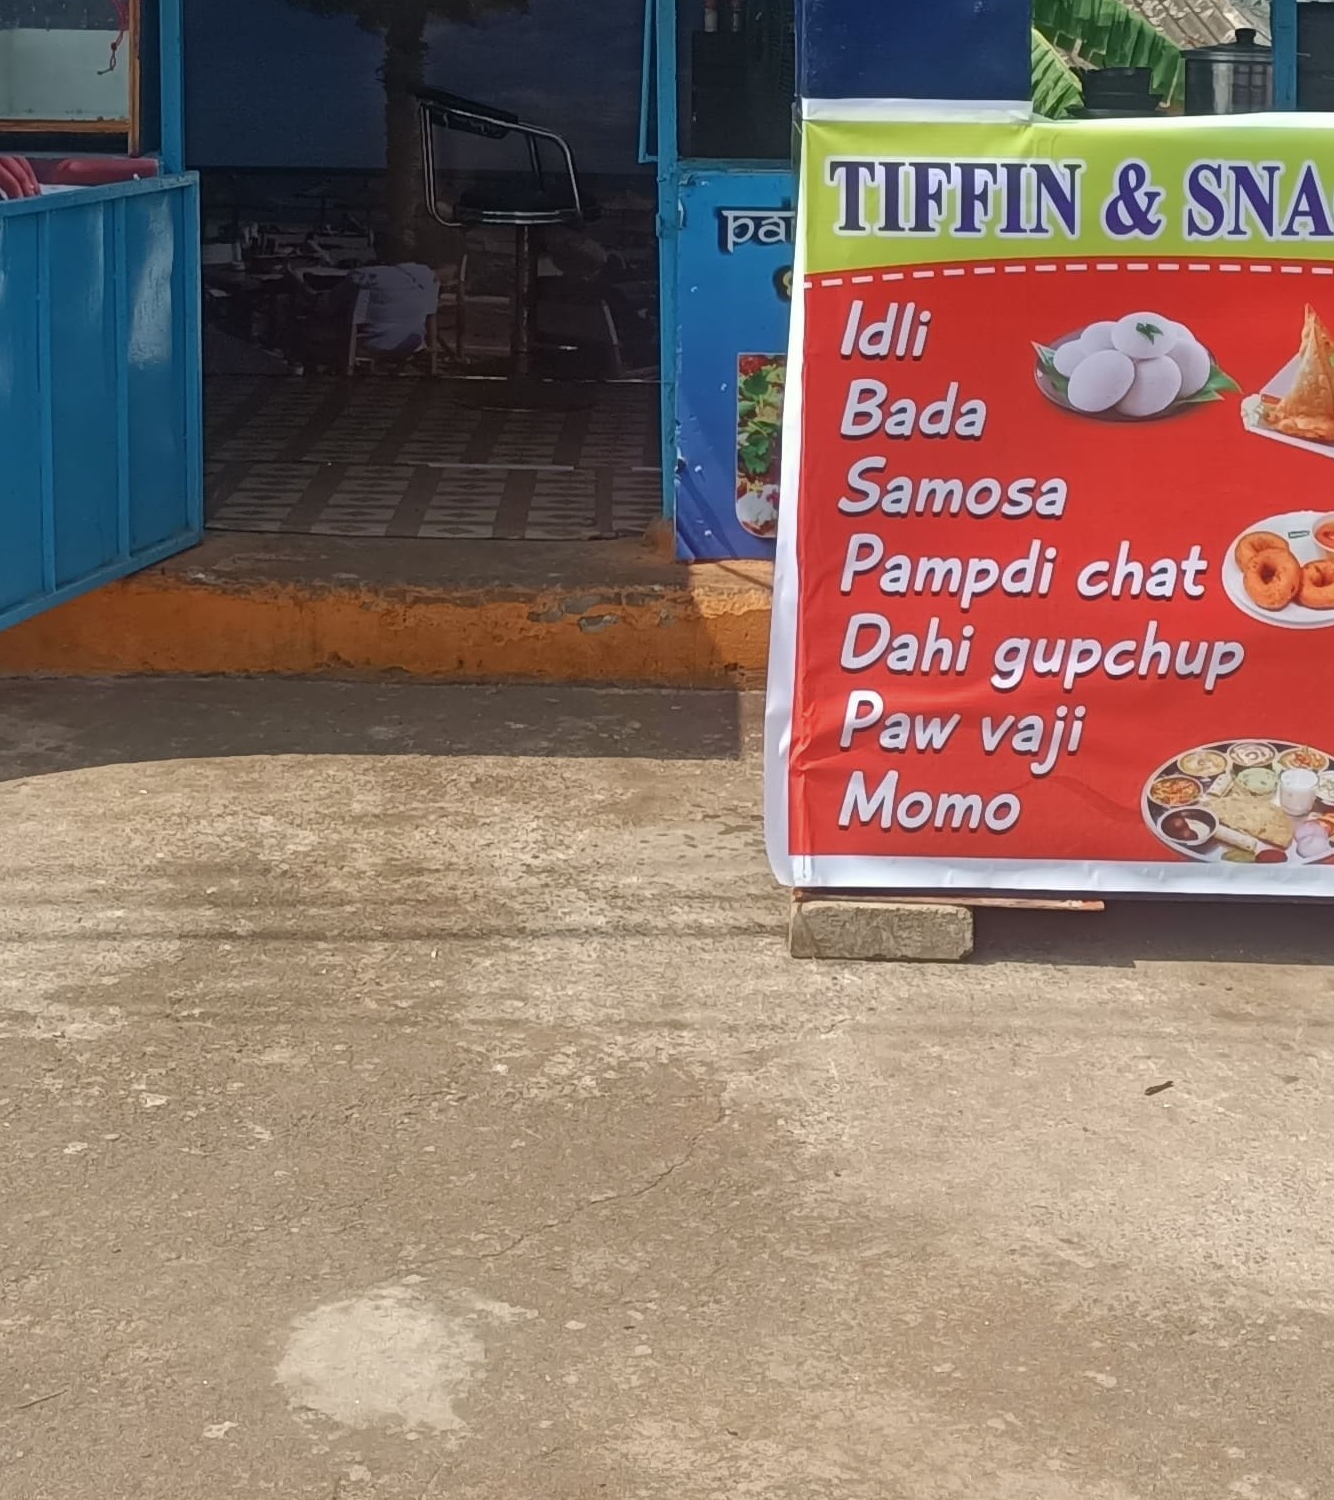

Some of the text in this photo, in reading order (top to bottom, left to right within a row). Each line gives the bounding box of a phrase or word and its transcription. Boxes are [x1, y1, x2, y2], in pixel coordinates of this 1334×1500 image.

[827, 158, 1084, 238] TIFFIN
[1103, 161, 1164, 237] &
[840, 300, 932, 359] Idli
[840, 378, 987, 439] Bada
[838, 456, 1067, 519] Samosa
[840, 533, 1208, 607] Pampdi chat
[840, 612, 1245, 689] Dahi gupchup
[840, 691, 1086, 775] Paw vaji
[838, 771, 1021, 832] Momo
